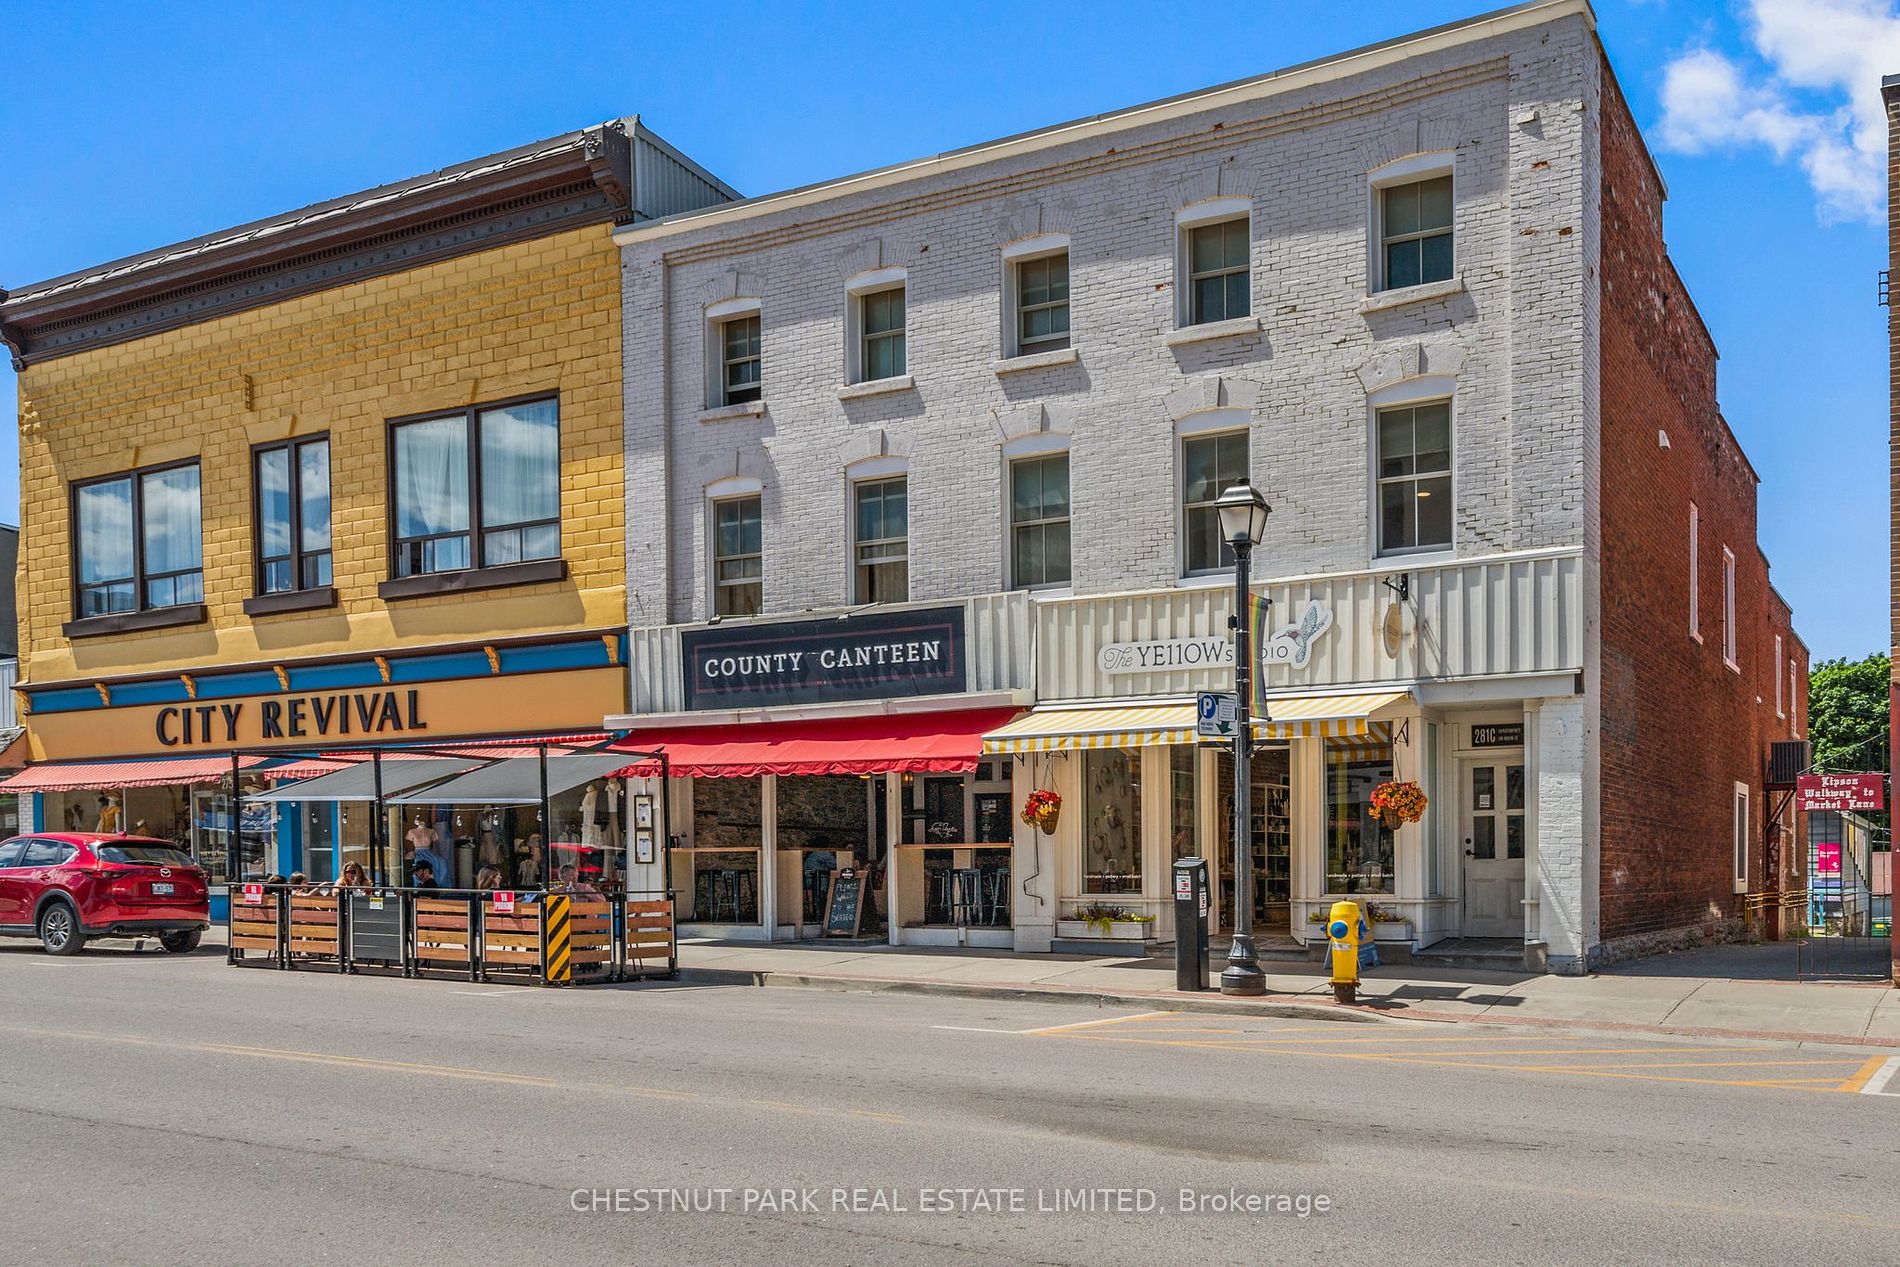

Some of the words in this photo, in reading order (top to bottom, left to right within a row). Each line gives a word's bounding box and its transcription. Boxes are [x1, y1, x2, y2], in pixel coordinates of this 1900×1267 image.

[704, 652, 803, 678] COUNTY
[820, 640, 941, 669] CANTEEN
[1103, 646, 1133, 670] The
[155, 703, 242, 746] CITY
[261, 690, 427, 739] REVIVAL
[1474, 727, 1496, 744] 281C
[1863, 787, 1875, 796] to
[1804, 799, 1841, 810] Market
